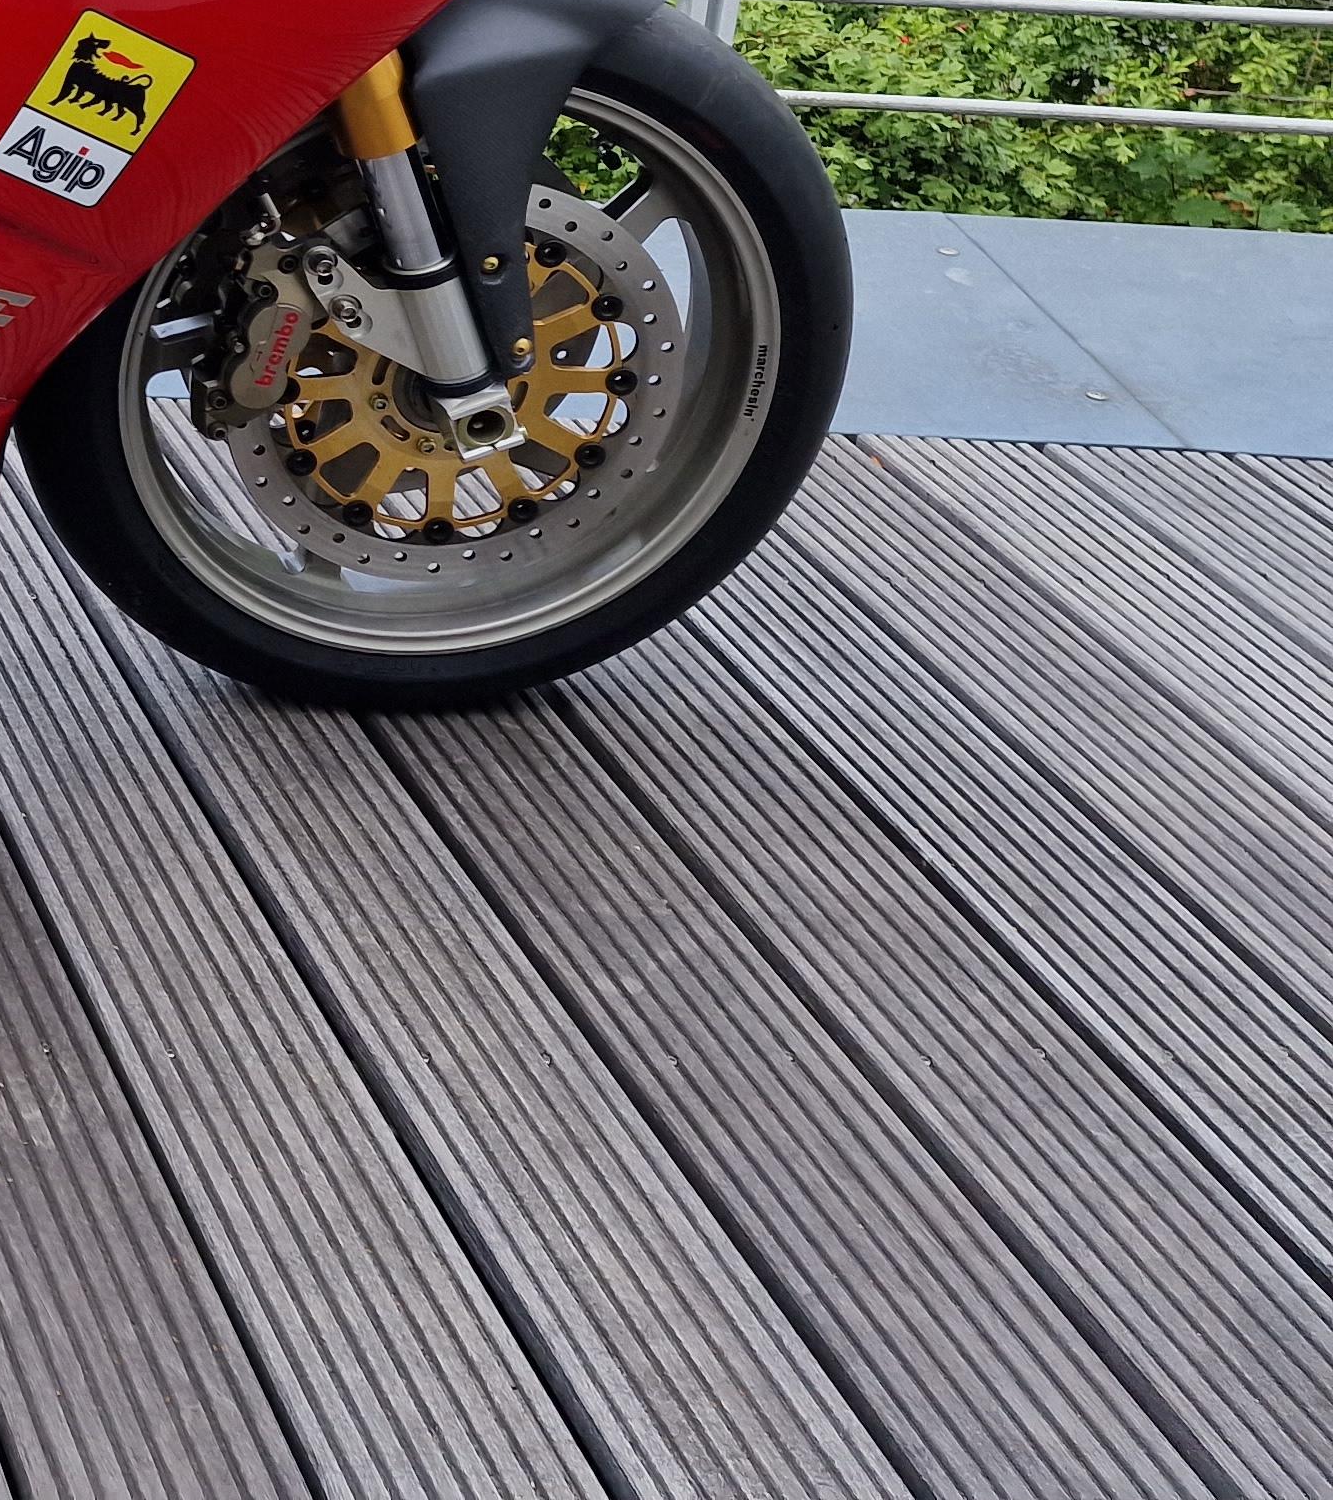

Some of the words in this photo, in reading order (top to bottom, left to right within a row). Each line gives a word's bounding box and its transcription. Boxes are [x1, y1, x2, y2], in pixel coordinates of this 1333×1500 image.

[2, 125, 106, 194] Agip
[254, 312, 300, 387] brembo
[743, 344, 768, 422] marchesin
